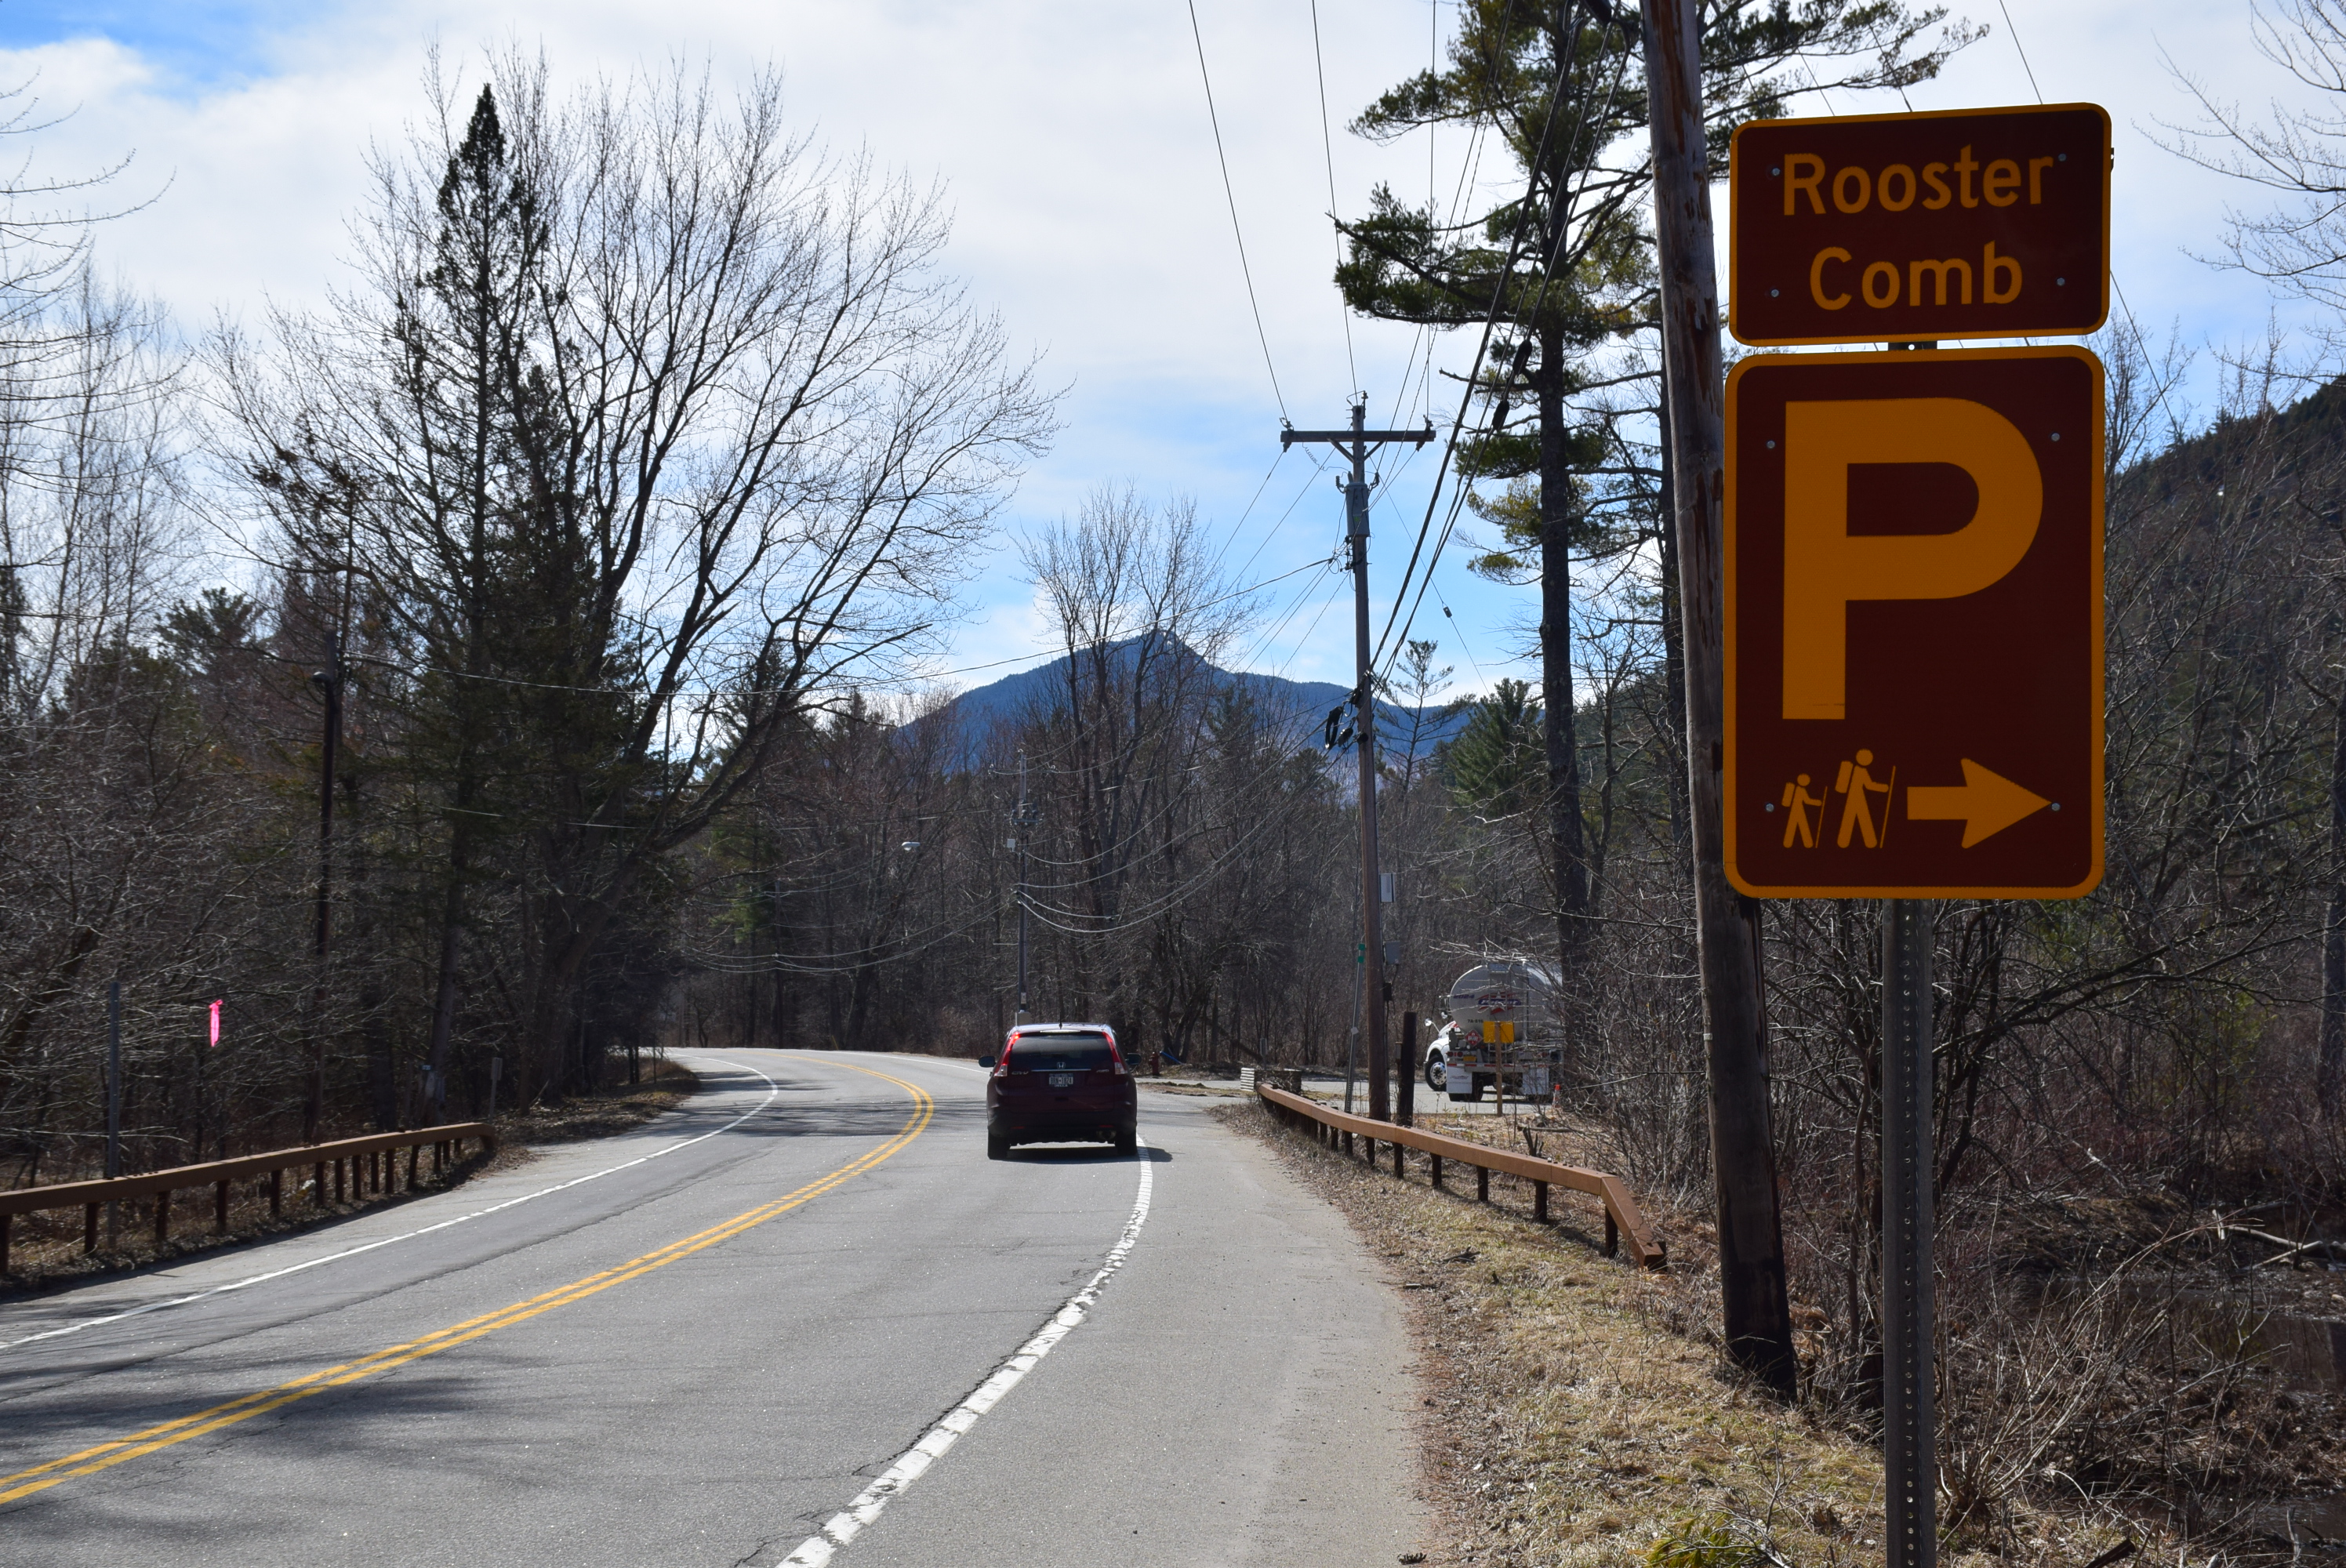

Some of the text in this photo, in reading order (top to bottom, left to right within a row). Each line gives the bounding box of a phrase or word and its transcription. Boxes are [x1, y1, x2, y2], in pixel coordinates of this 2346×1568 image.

[1784, 143, 2054, 216] Rooster
[1810, 239, 2023, 310] Comb
[1782, 397, 2043, 720] P
